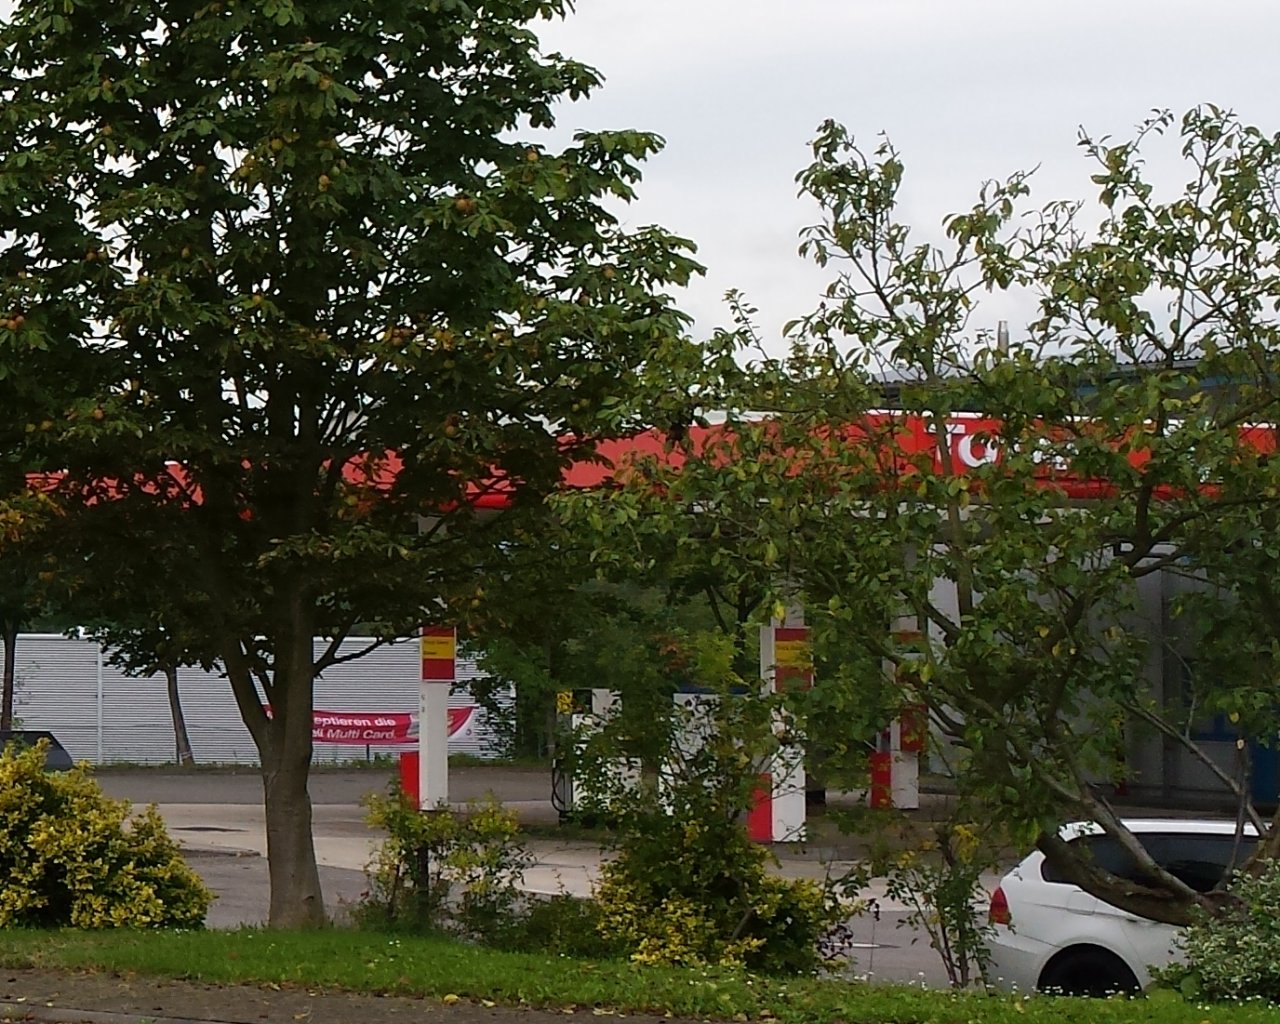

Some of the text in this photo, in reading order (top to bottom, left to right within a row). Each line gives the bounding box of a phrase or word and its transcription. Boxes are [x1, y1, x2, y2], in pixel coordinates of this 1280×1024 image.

[313, 716, 396, 728] eptieren die
[327, 729, 360, 739] Multi
